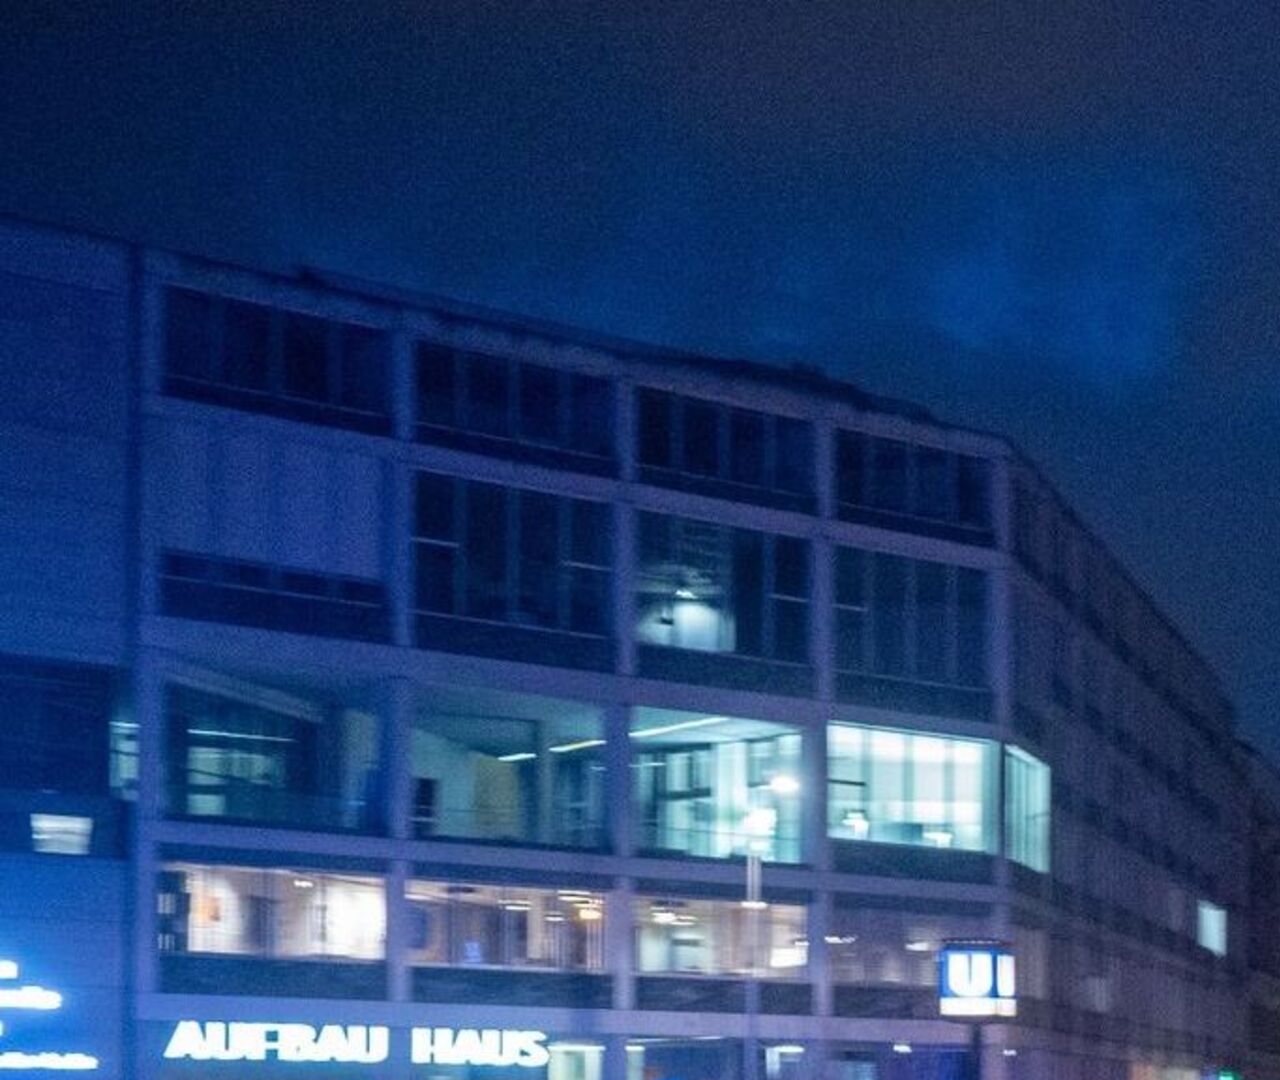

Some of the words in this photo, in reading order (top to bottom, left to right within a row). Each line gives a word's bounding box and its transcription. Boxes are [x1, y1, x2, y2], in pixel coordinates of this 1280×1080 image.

[948, 952, 993, 997] U
[164, 1021, 389, 1063] AUFBAU
[411, 1027, 550, 1067] HAUS
